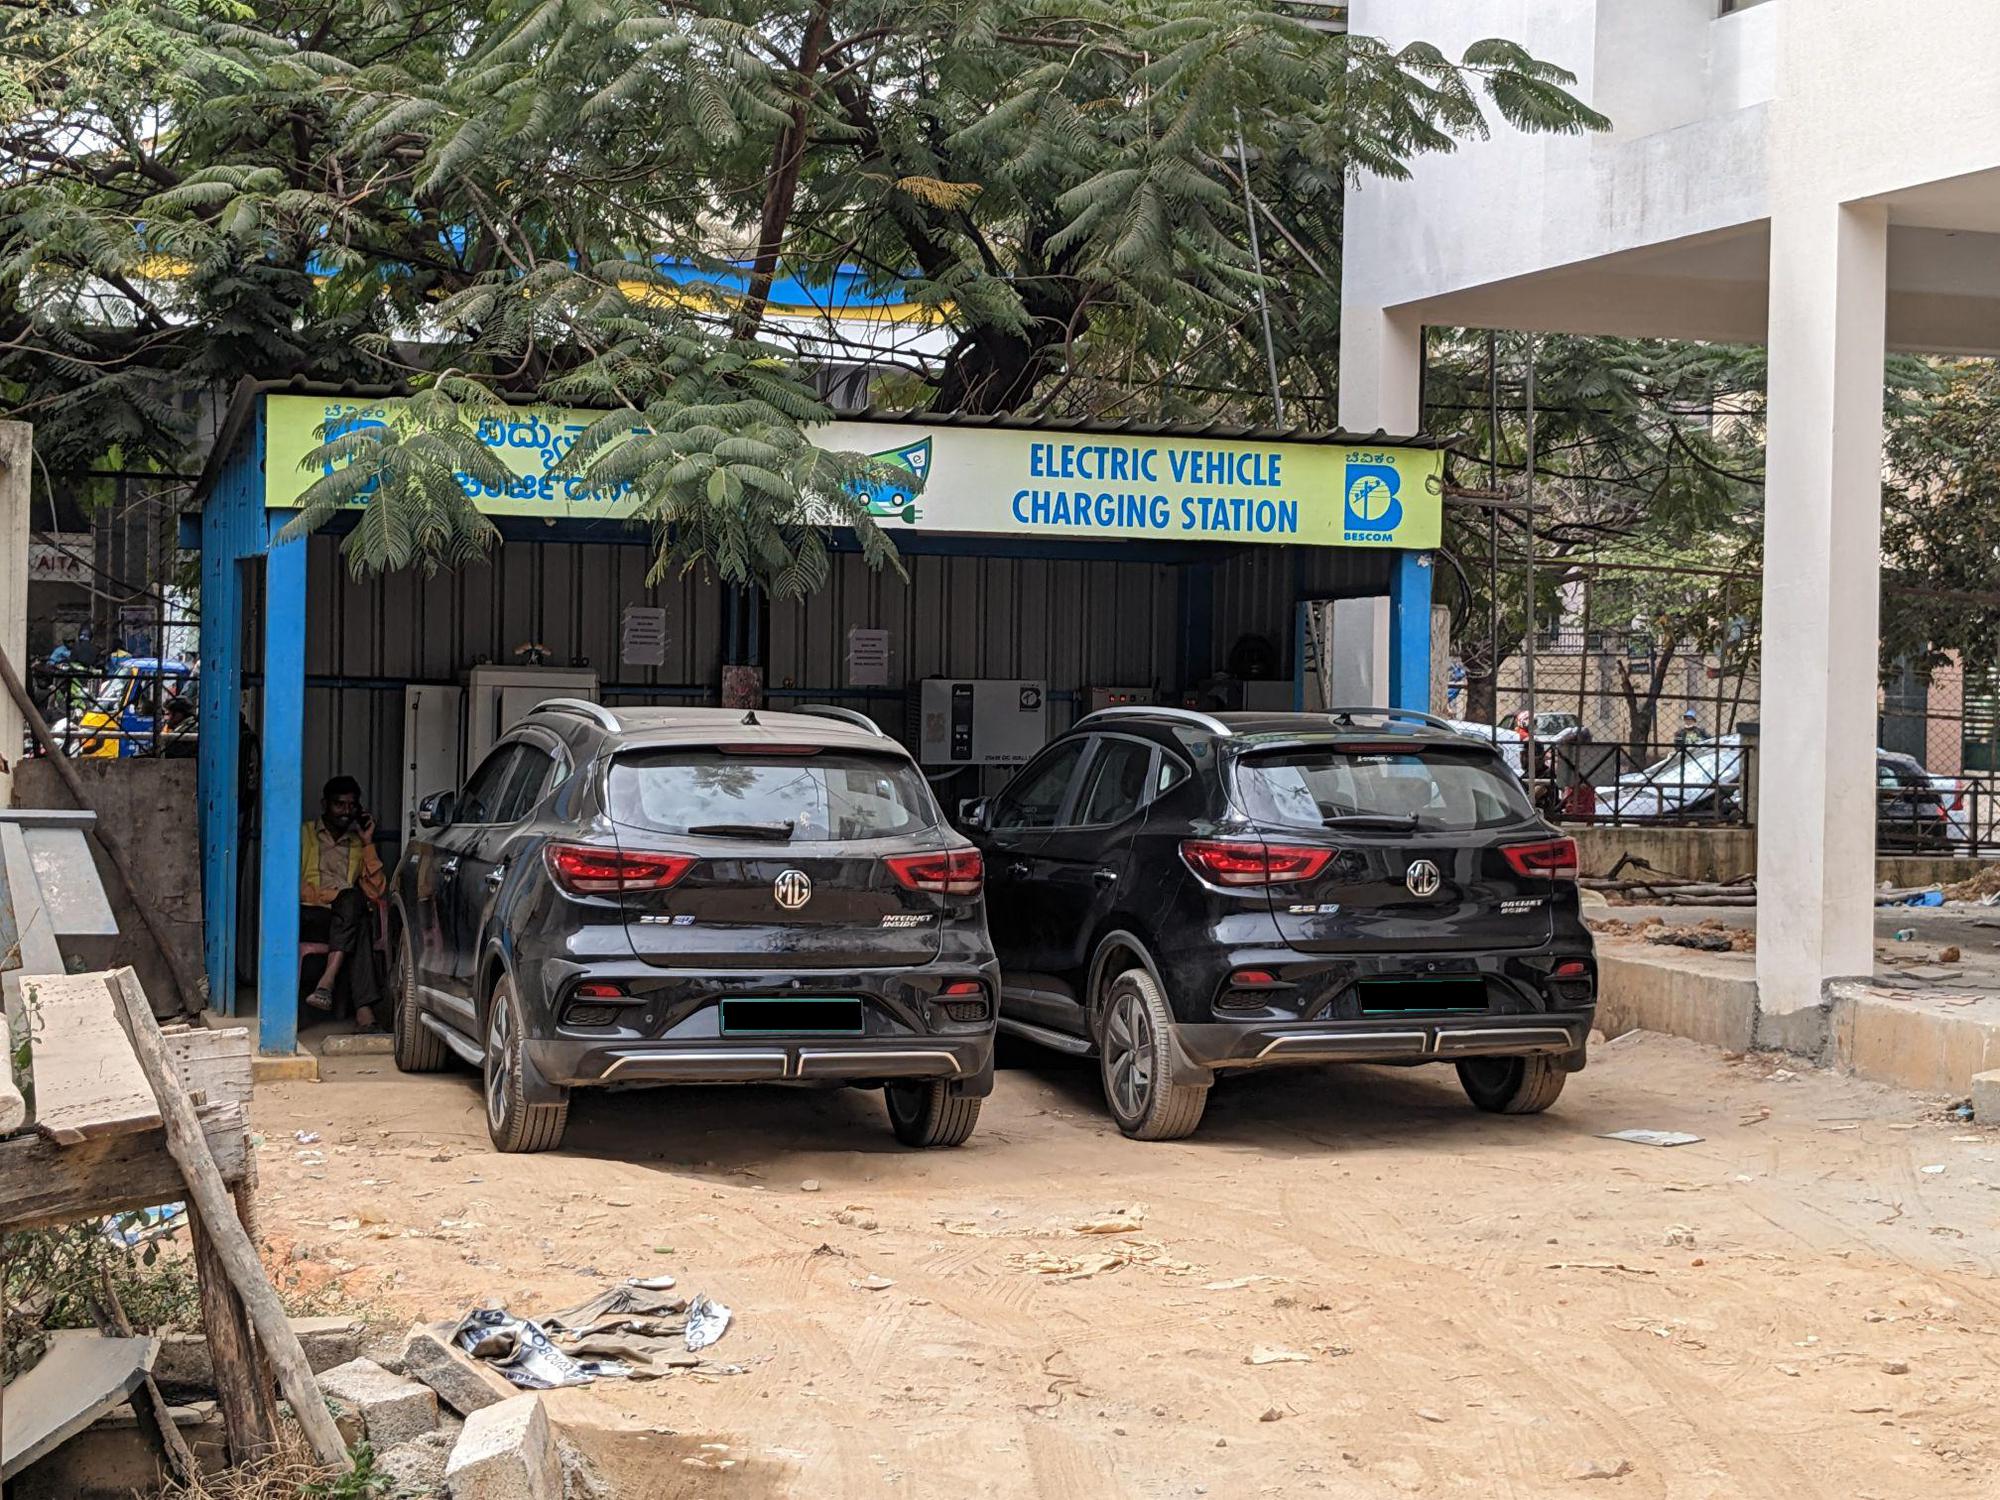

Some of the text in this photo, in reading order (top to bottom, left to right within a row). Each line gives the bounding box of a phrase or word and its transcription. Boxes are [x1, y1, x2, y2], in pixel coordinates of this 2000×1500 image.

[1031, 443, 1281, 486] ELECTRIC VEHICLE
[1012, 490, 1297, 533] CHARGING STATION
[1343, 532, 1393, 542] BESCOM
[778, 873, 809, 905] MG
[1410, 862, 1437, 893] MG
[882, 914, 933, 922] INTERNET
